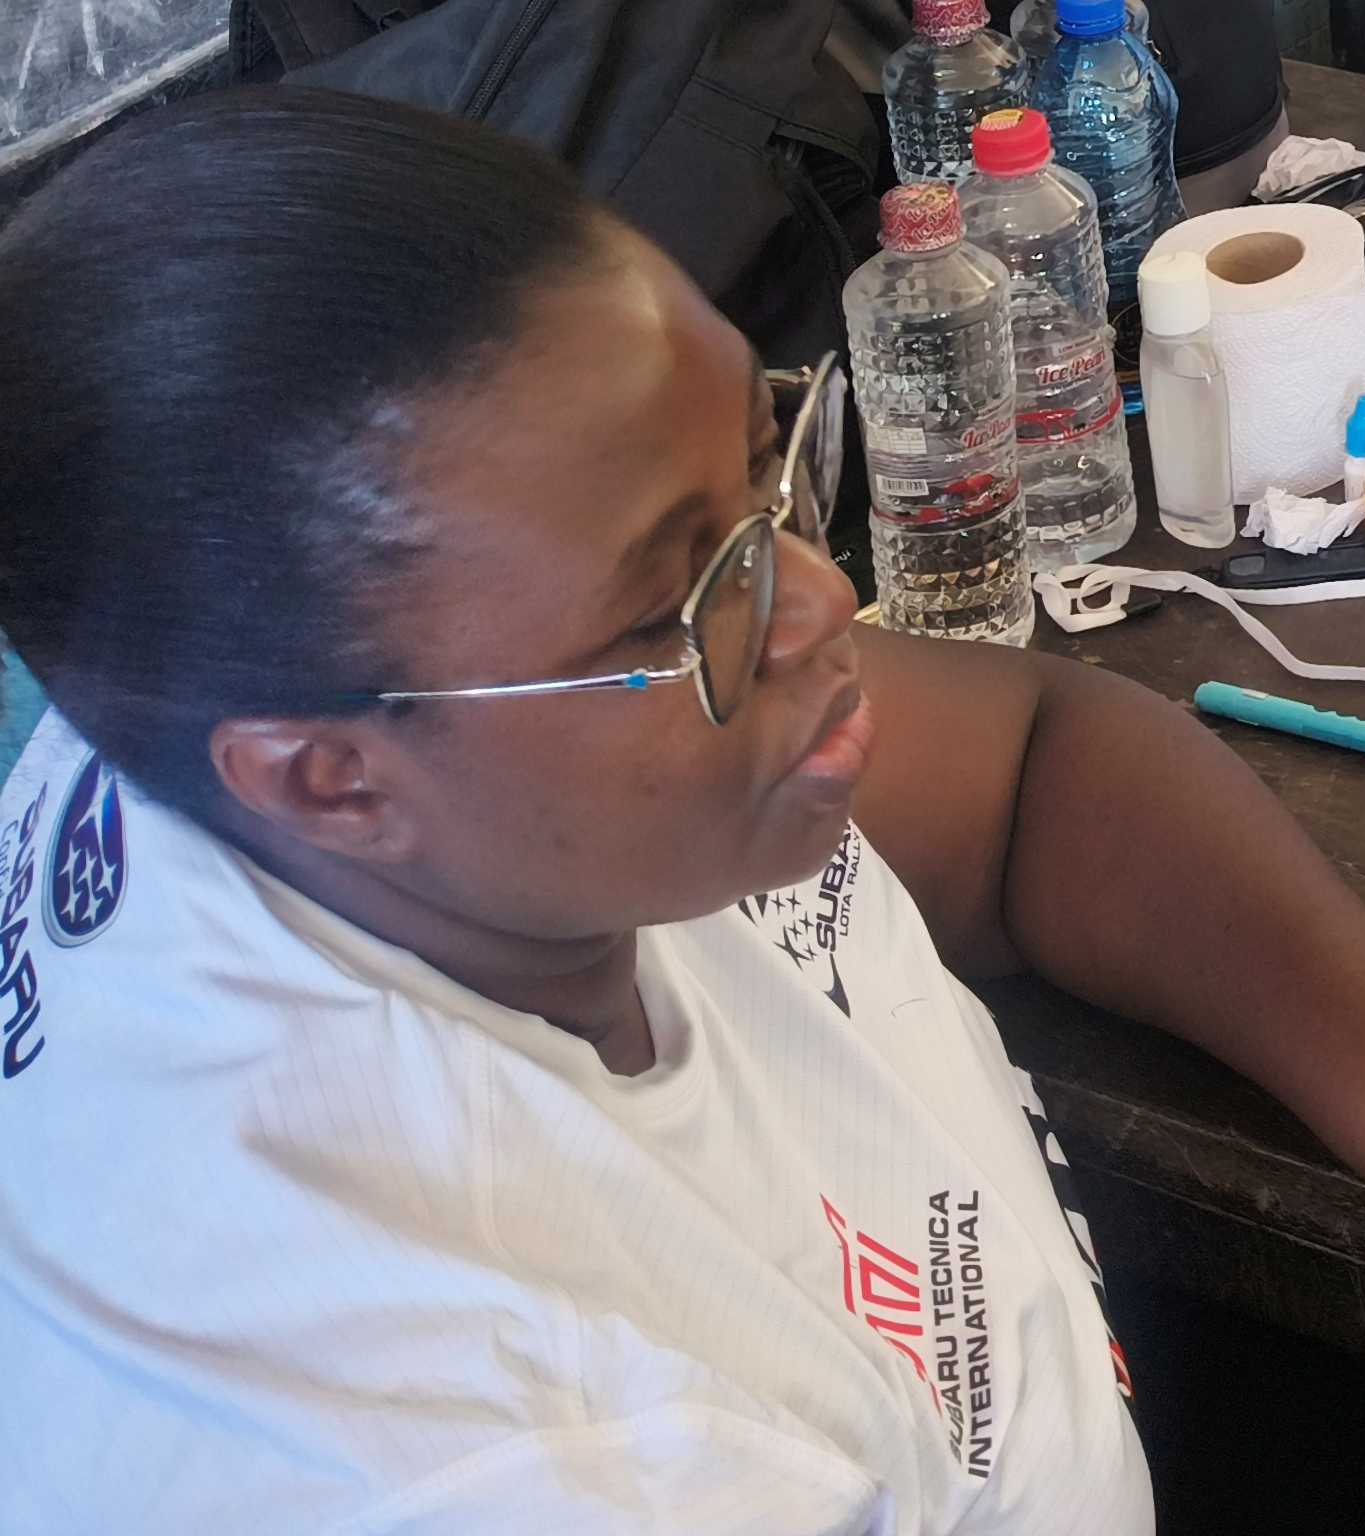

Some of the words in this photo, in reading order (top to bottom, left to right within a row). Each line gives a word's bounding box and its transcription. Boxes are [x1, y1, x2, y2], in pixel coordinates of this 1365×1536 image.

[840, 894, 853, 936] LOTA
[847, 832, 861, 885] RALLY
[929, 1190, 954, 1327] TECNICA
[958, 1190, 994, 1478] INTERNATIONAL
